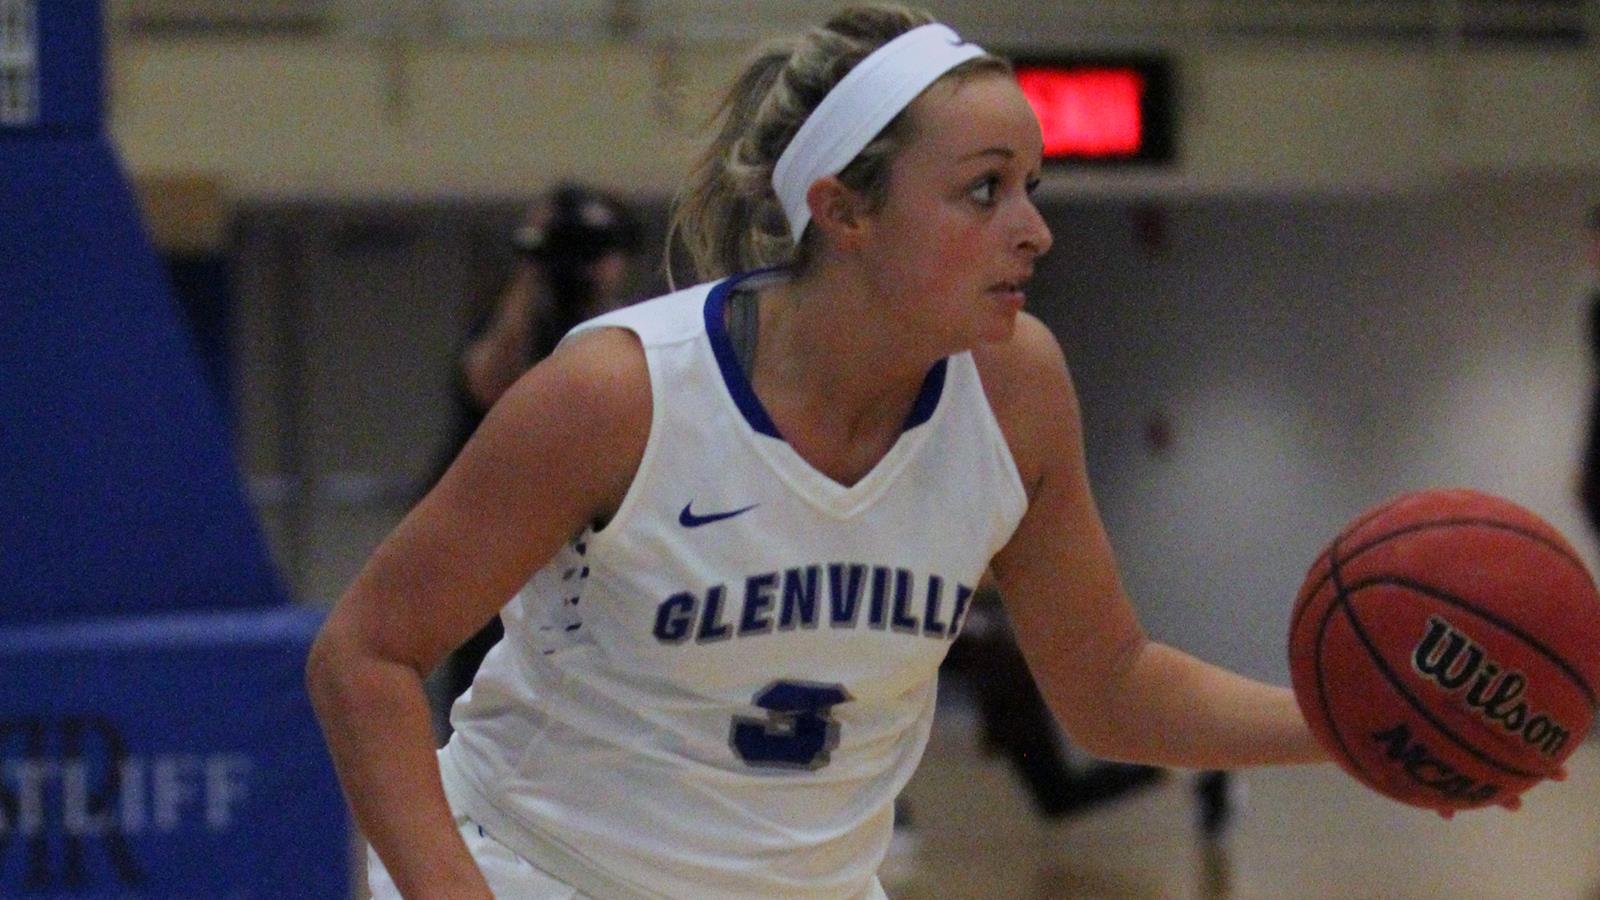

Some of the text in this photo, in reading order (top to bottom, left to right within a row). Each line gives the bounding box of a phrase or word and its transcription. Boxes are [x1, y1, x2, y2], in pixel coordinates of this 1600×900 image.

[729, 679, 856, 771] 3
[1411, 615, 1571, 757] Wilson
[0, 752, 252, 835] TLIFF
